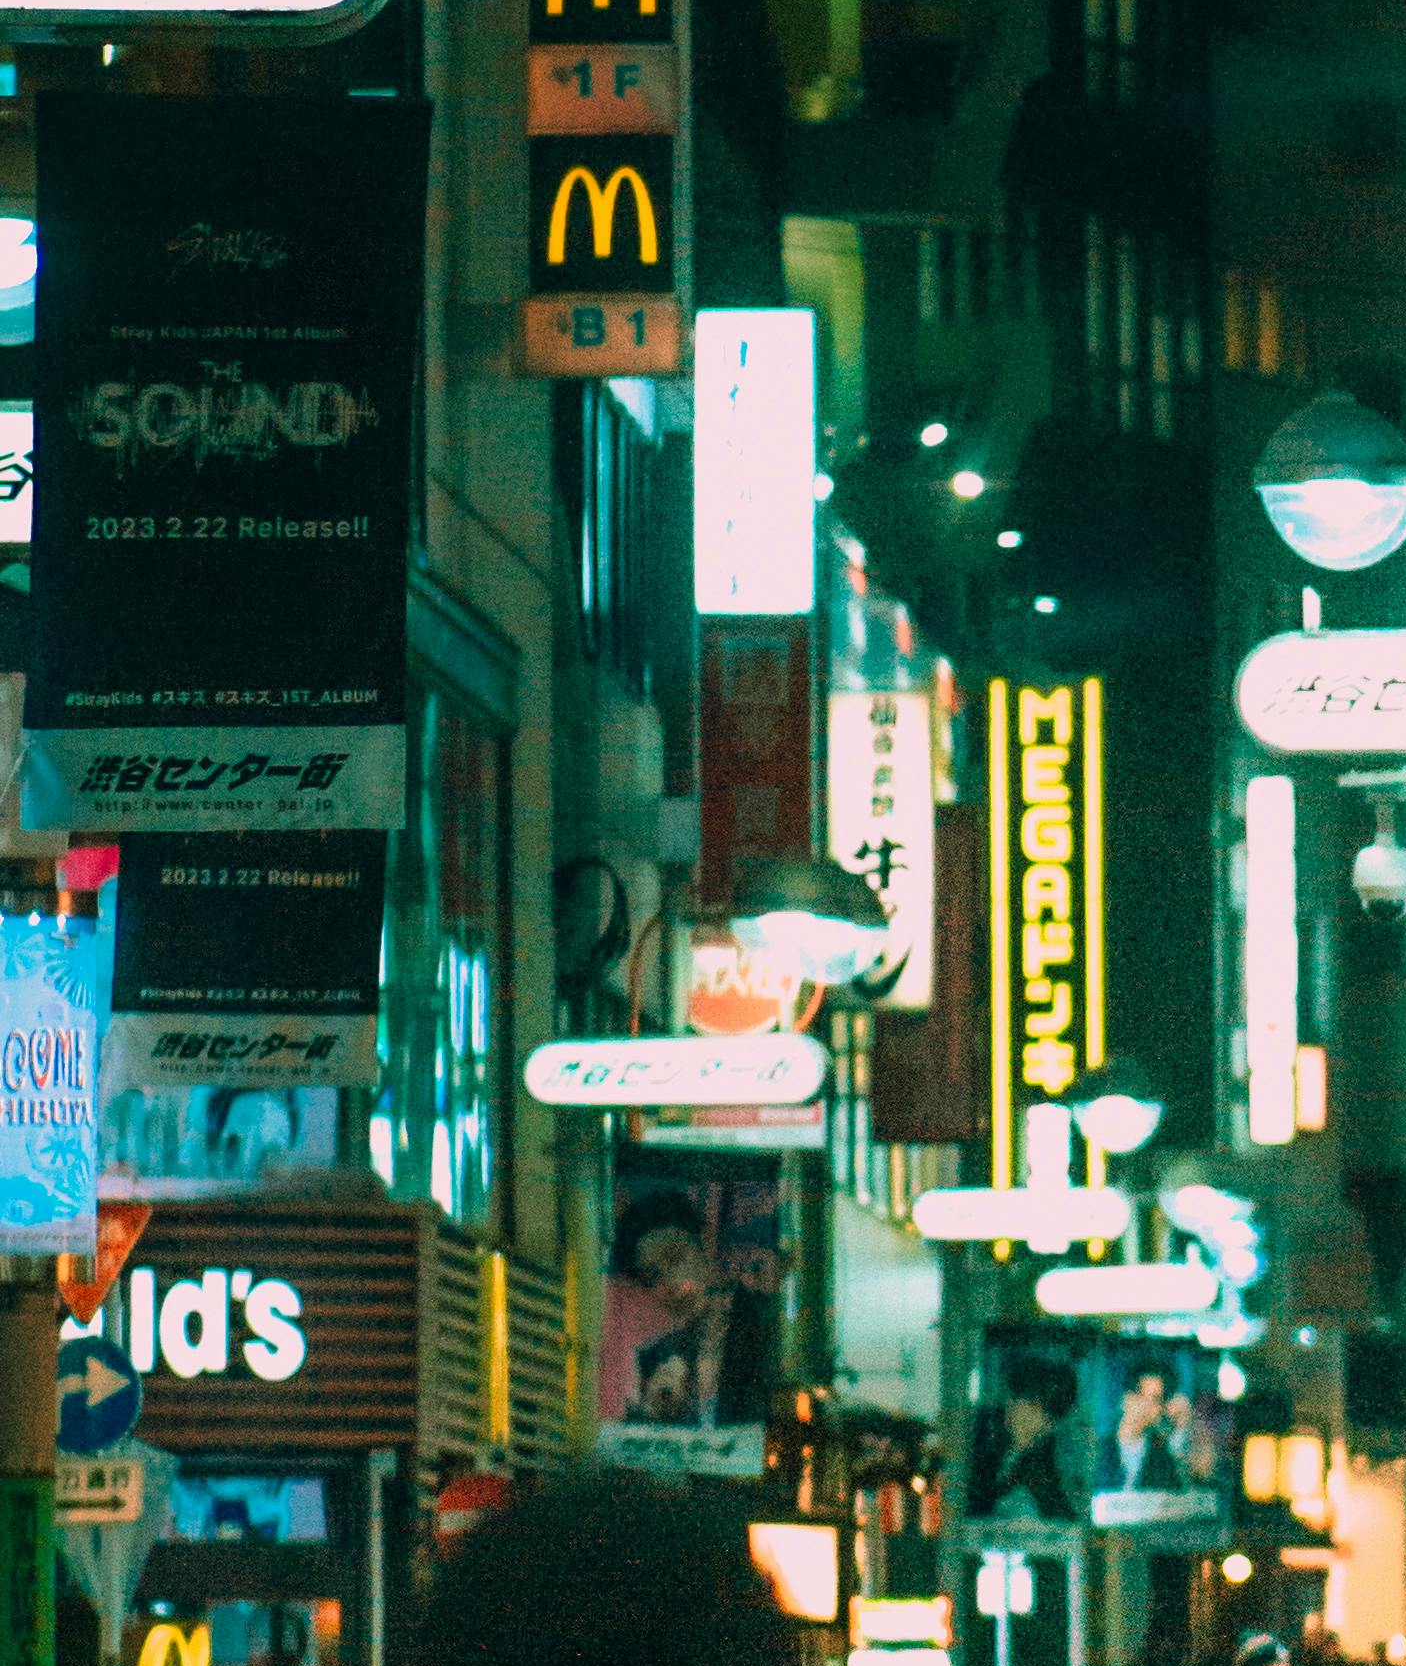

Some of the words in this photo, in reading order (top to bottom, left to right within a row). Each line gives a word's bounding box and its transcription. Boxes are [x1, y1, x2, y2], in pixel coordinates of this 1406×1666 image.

[82, 381, 362, 449] SOUND
[86, 517, 228, 539] 2023.2.22
[238, 516, 369, 539] Release!!
[80, 753, 349, 793] 渋谷センター街
[1018, 688, 1074, 1094] MEGAドンキ
[151, 1033, 339, 1060] 渋谷センター街
[60, 1267, 308, 1381] ld's
